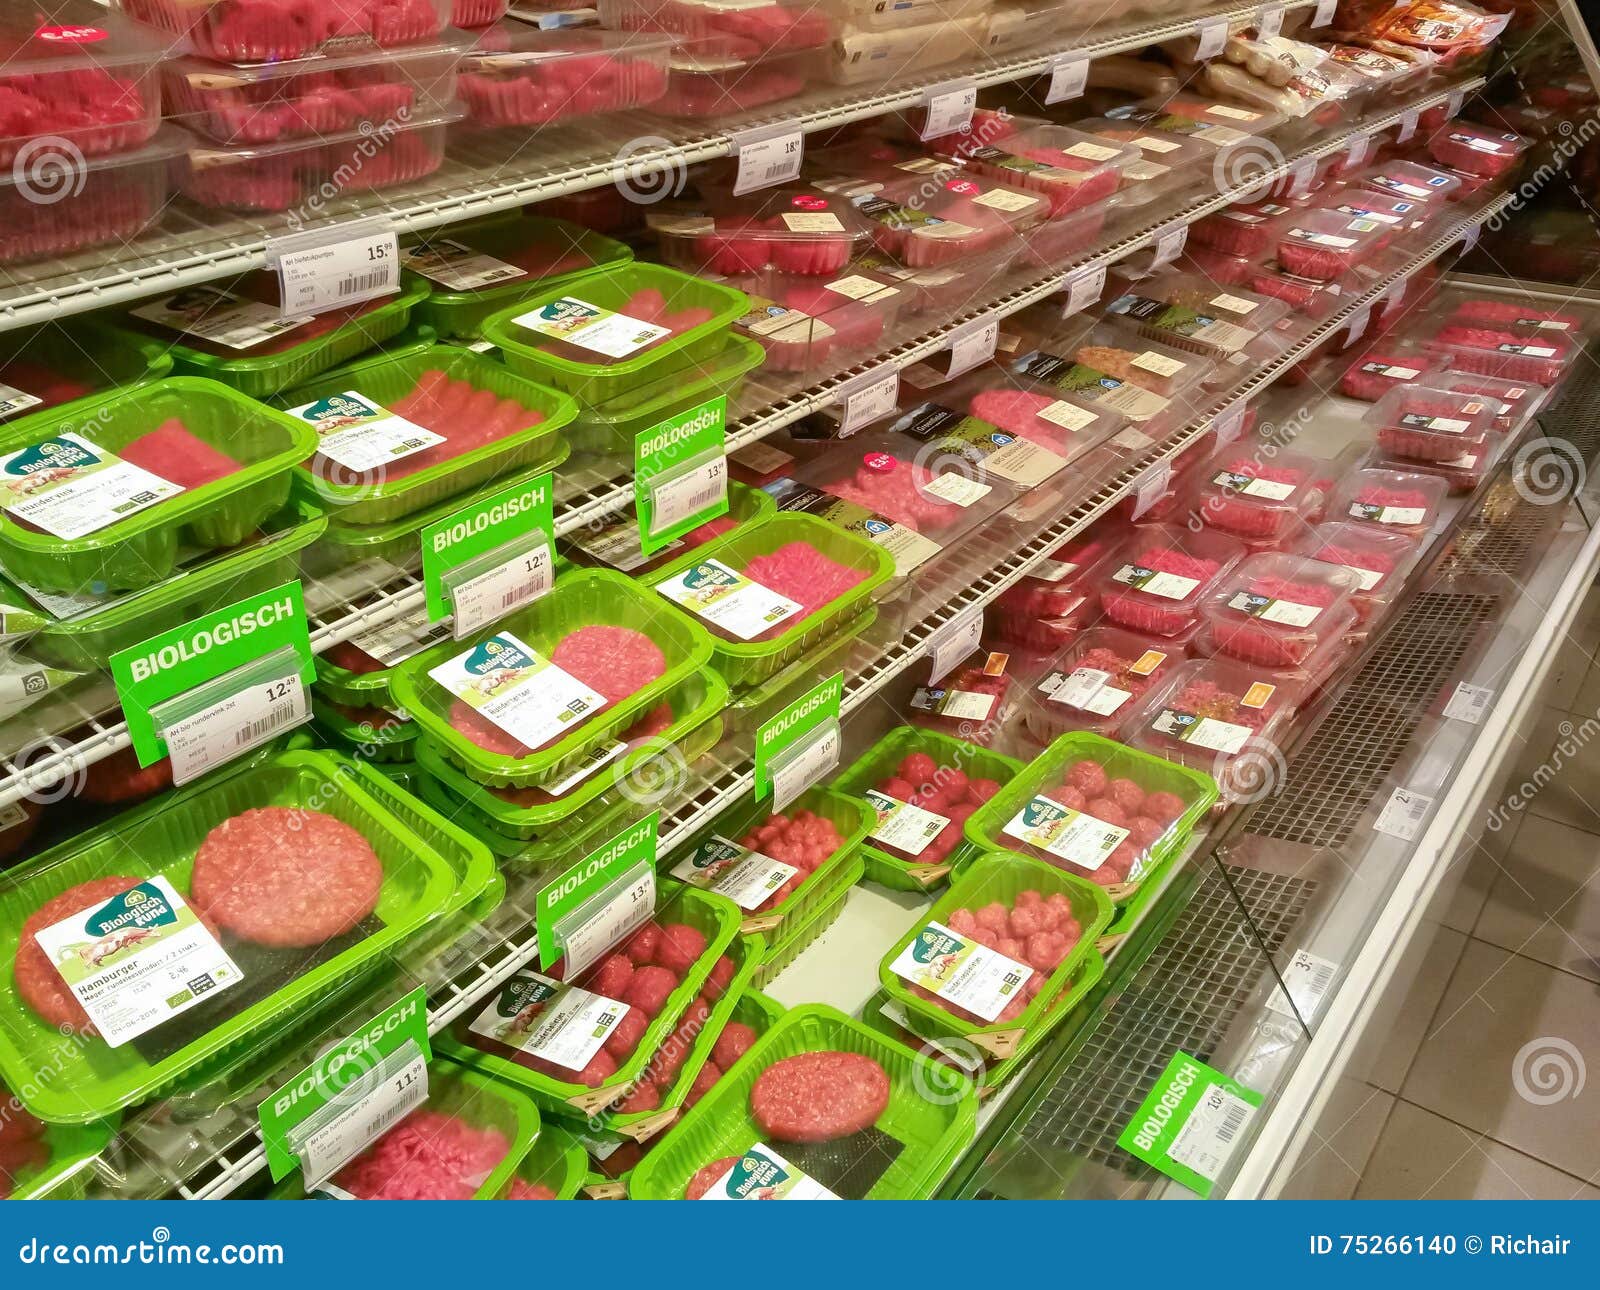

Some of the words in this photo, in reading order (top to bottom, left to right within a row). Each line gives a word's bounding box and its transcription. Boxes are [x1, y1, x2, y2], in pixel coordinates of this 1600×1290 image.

[367, 242, 393, 261] 15.99
[640, 408, 721, 459] BIOLOGISCH
[20, 445, 82, 475] Biologisch
[432, 486, 546, 554] BIOLOGISCH
[525, 552, 547, 573] 12.99
[129, 597, 295, 684] BIOLOGISCH
[475, 646, 516, 674] Biologisch
[266, 677, 296, 703] 12.49
[762, 683, 838, 747] BIOLOGISCH
[170, 730, 180, 738] AH
[547, 823, 652, 909] BIOLOGISCH
[98, 896, 163, 934] Biologisch
[77, 959, 140, 996] Hamburger
[273, 1000, 417, 1118] BIOLOGISCH
[395, 1063, 423, 1094] 11.99
[1132, 1062, 1201, 1151] BIOLOGISCH
[736, 1160, 772, 1196] Biologisch
